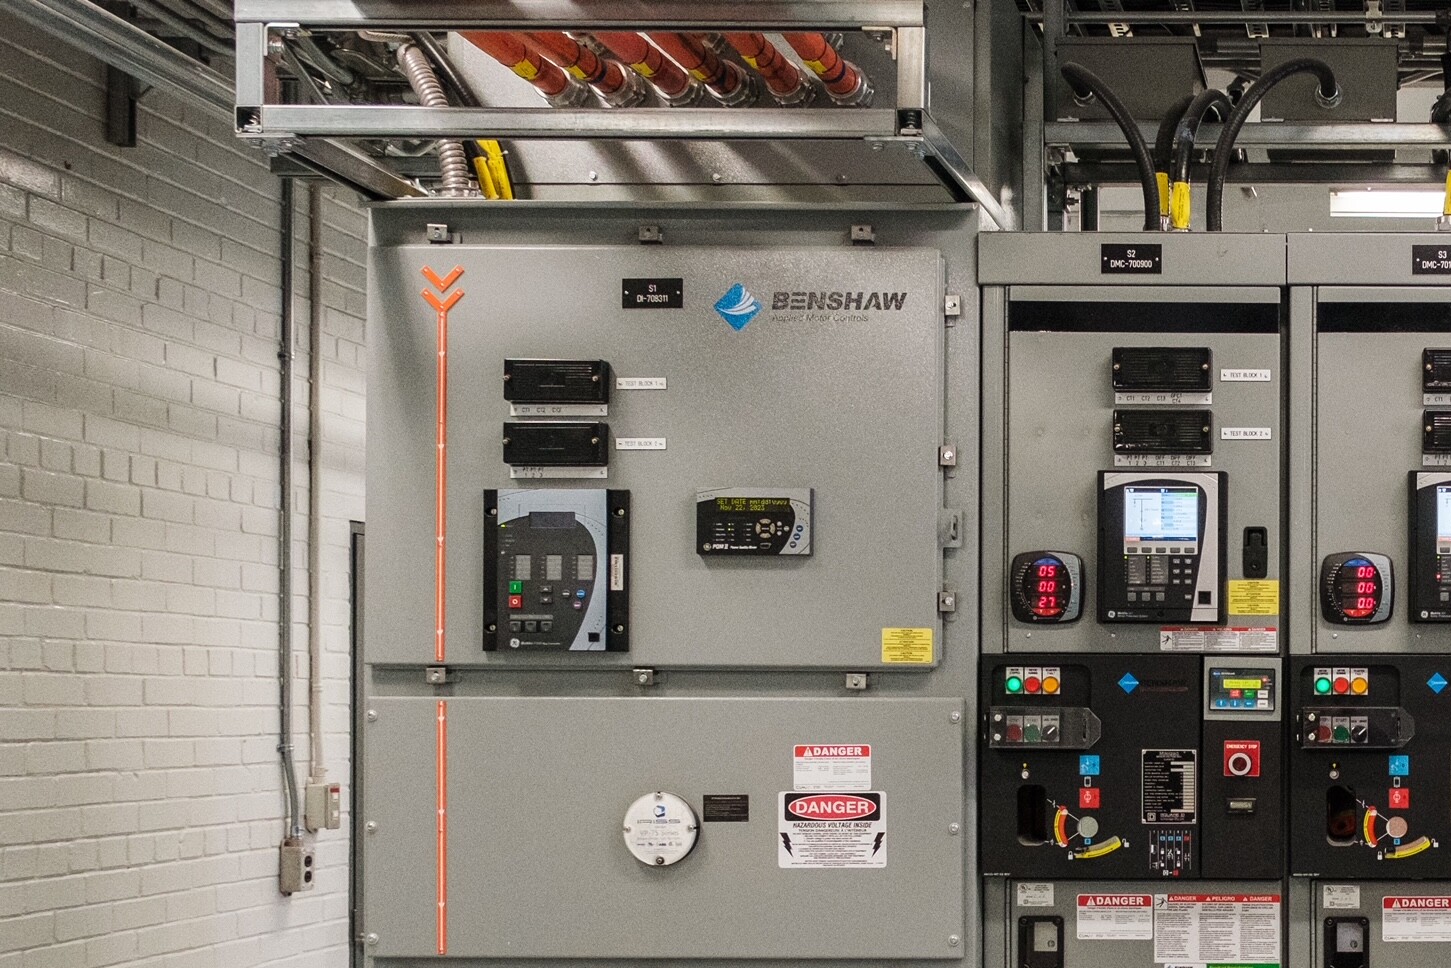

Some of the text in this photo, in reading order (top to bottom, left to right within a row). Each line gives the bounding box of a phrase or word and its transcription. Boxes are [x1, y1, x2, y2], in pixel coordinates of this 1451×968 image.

[1127, 250, 1136, 258] S2
[1438, 250, 1447, 259] S3
[1110, 260, 1153, 269] DMC-700900
[648, 284, 657, 293] S1
[771, 291, 908, 311] BENSHAW
[771, 314, 869, 323] Applied Motor Controls
[1038, 566, 1055, 577] 05
[1358, 566, 1374, 578] 00
[1038, 582, 1055, 592] 00
[1358, 582, 1374, 594] 00
[1038, 596, 1055, 608] 27
[814, 747, 862, 756] DANGER
[796, 801, 869, 814] DANGER
[1096, 896, 1144, 905] DANGER
[1401, 898, 1450, 908] DANGER
